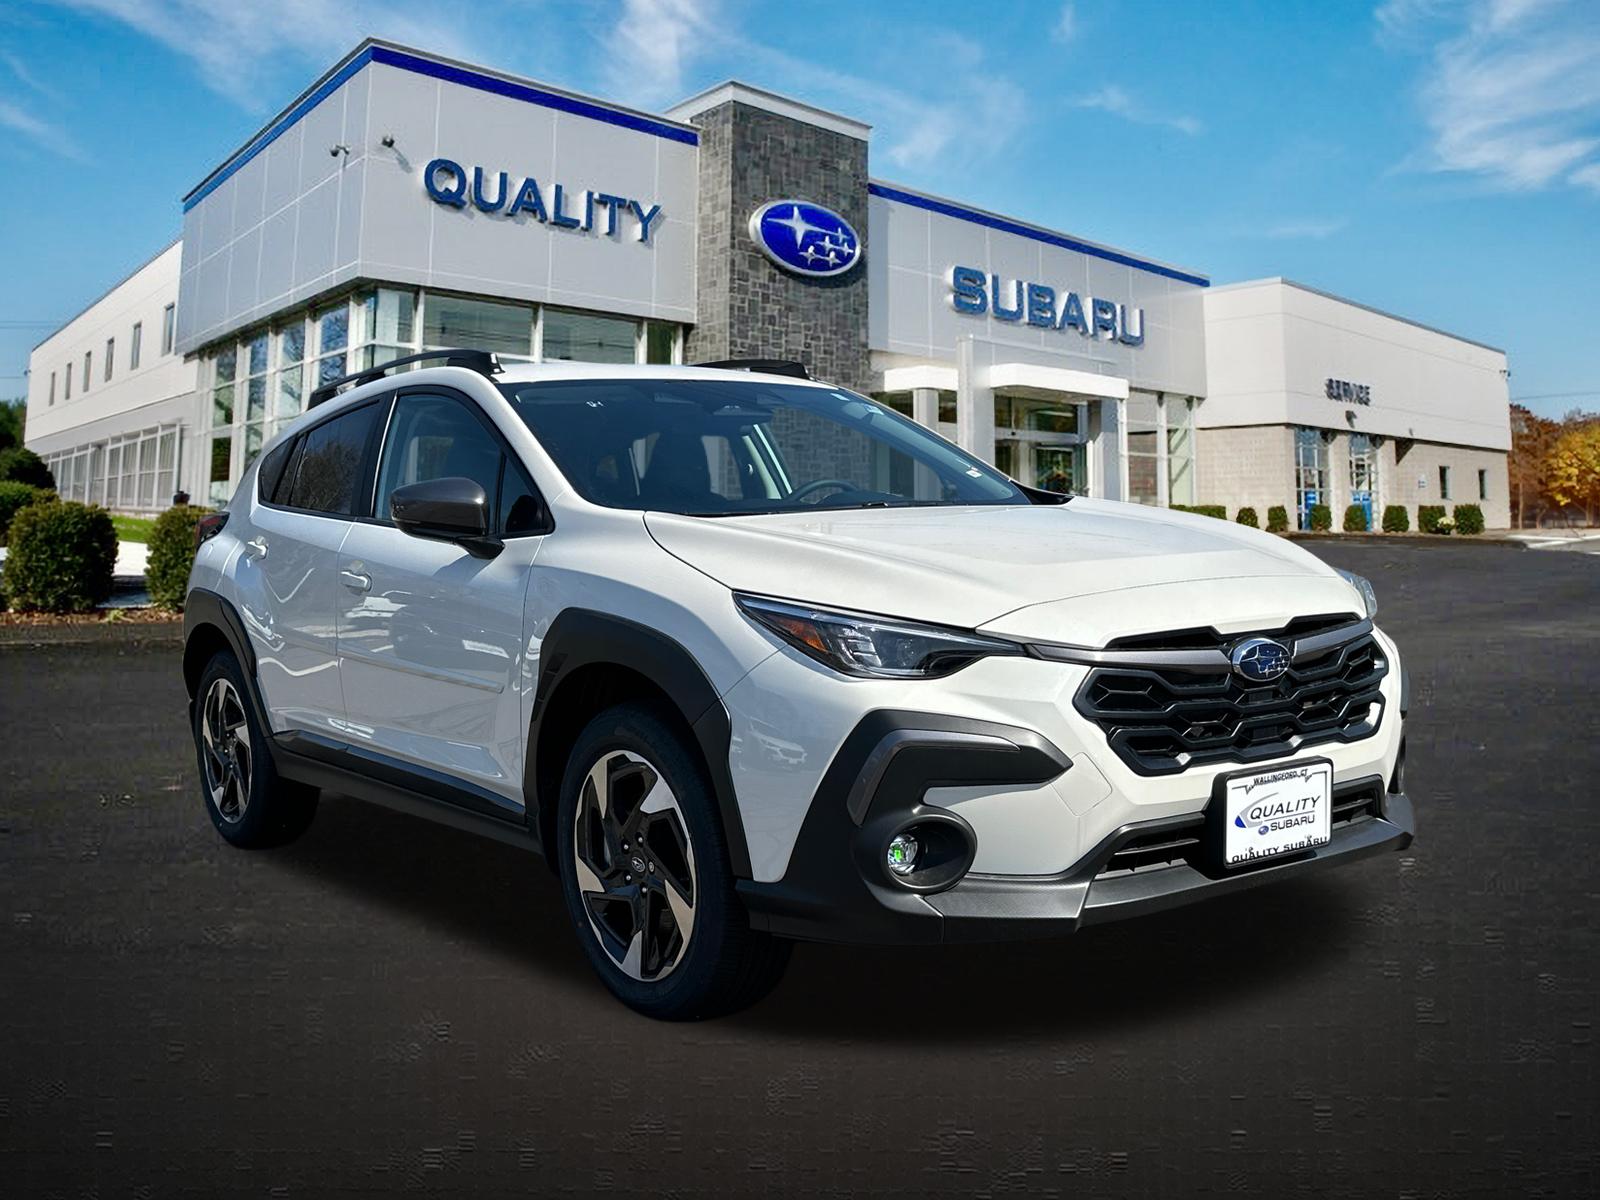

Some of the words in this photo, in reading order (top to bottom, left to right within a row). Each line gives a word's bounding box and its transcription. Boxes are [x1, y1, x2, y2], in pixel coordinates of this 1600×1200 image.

[424, 158, 662, 242] QUALITY
[951, 265, 1145, 346] SUBARU
[1325, 378, 1371, 407] SERVICE
[1250, 795, 1321, 820] QUALITY
[1270, 815, 1315, 832] SUBARU
[1232, 846, 1280, 862] QUALITY
[1283, 836, 1328, 852] SUBARU
